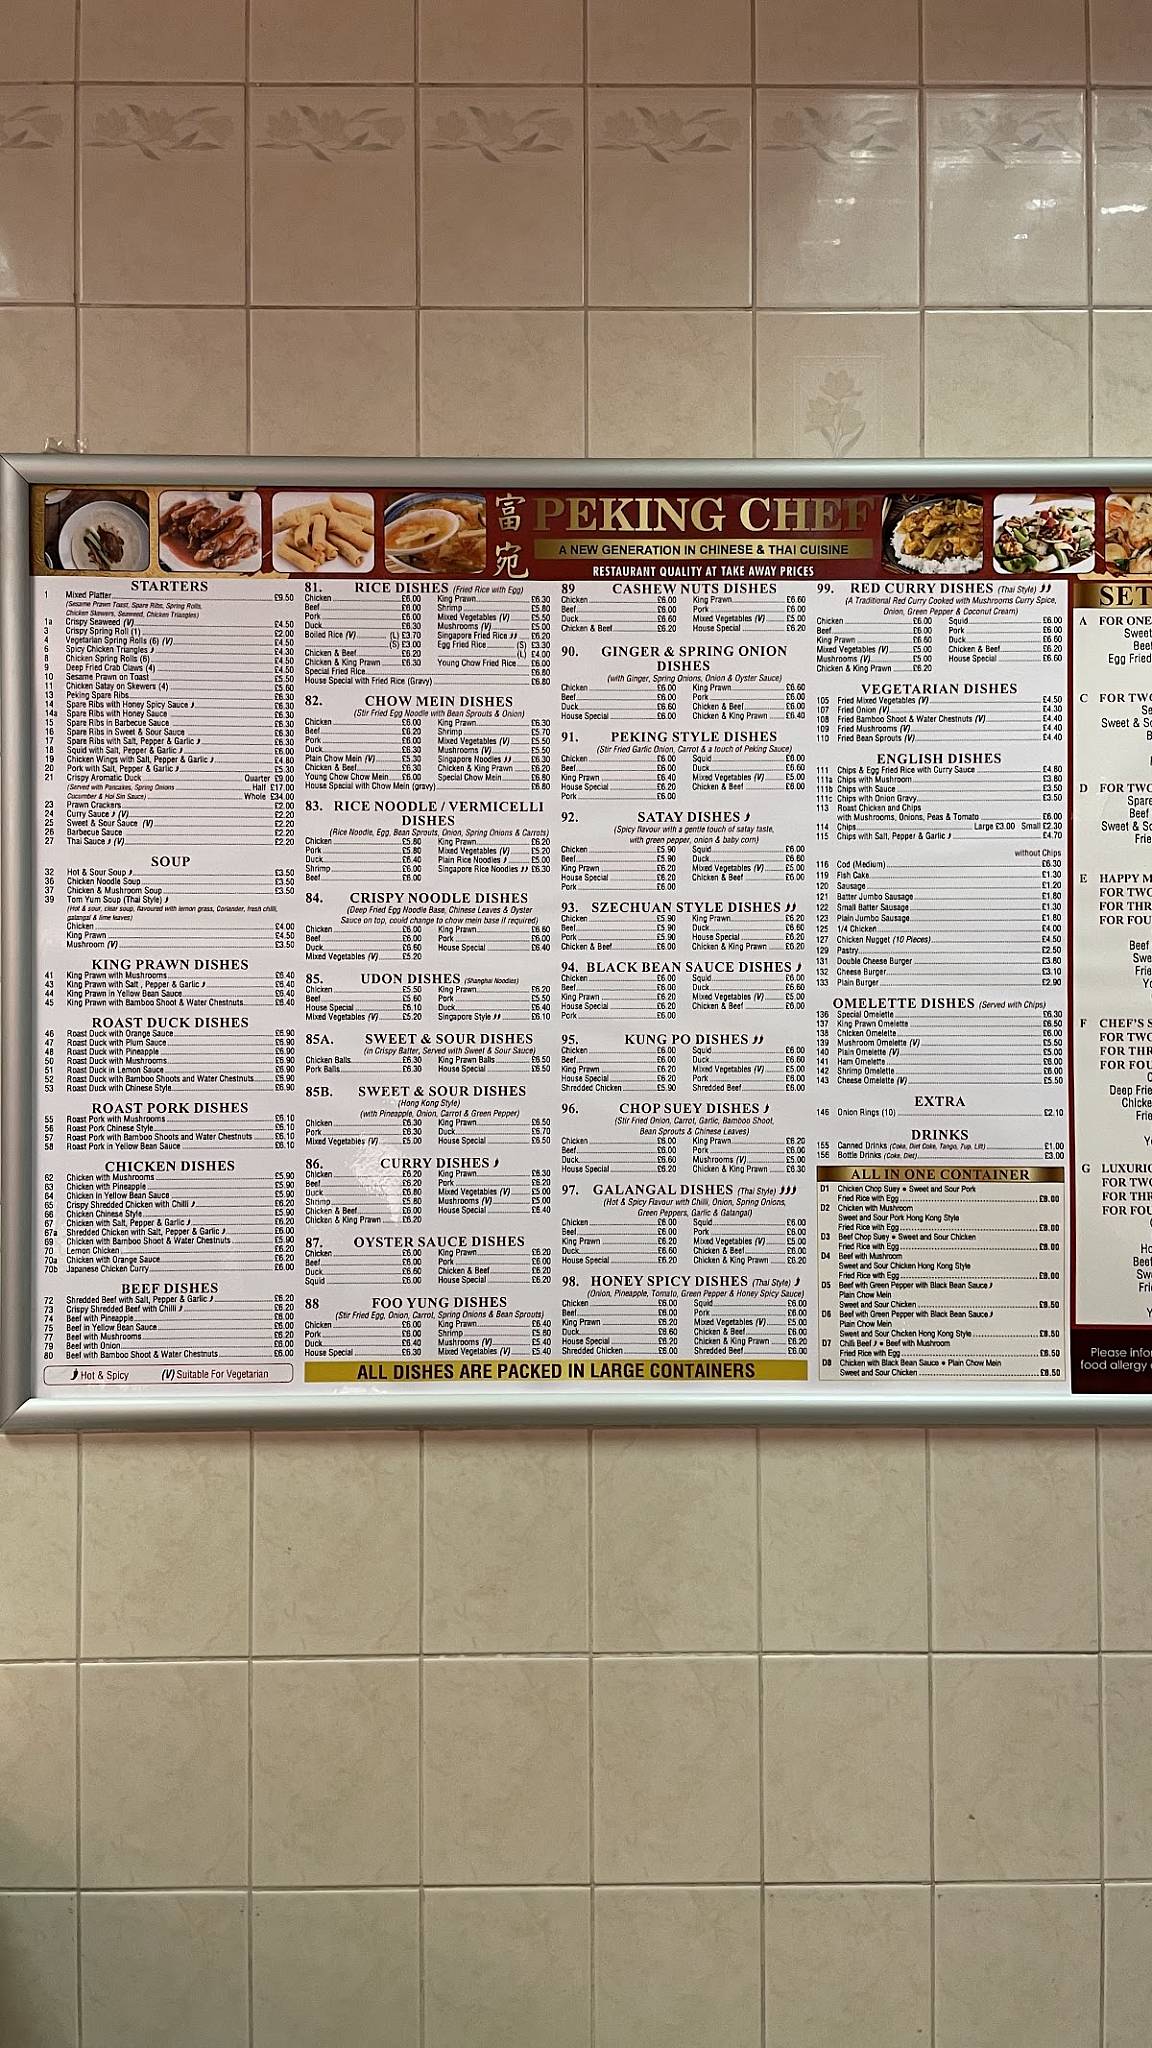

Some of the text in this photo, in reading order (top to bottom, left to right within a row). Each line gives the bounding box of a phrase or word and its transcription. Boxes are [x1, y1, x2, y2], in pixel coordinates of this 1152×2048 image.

[532, 497, 873, 532] PEKING CHEF
[559, 544, 849, 555] A NEW GENERATION IN CHINESE & THAI CUISINE
[593, 565, 814, 577] RESTAURANT QUALITY AT TAKE AWAY PRICES
[130, 580, 208, 592] STARTERS
[304, 581, 524, 595] 81. RICE DISHES (Fried Rice with Egg)
[561, 582, 777, 595] 89 CASHEW NUTS DISHES
[817, 582, 1037, 595] 99. RED CURRY DISHES (Thai Style)
[65, 590, 87, 599] Mixed
[88, 590, 112, 599] Platter
[273, 593, 295, 602] £9.50
[304, 594, 422, 603] Chicken £6.00
[1080, 617, 1087, 625] A
[1099, 616, 1123, 625] FOR
[561, 645, 788, 658] 90. GINGER & SPRING ONION
[1108, 653, 1152, 665] Egg Fried
[657, 660, 710, 672] DISHES
[44, 672, 54, 681] 10
[65, 672, 94, 681] Sesame
[95, 672, 117, 681] Prawn
[129, 672, 150, 682] Toast
[861, 682, 1018, 695] VEGETARIAN DISHES
[304, 694, 513, 708] 82. CHOW MEIN DISHES
[816, 695, 1063, 706] 105 Fried Mixed Vegetables (V) £4.50
[877, 752, 1002, 765] ENGLISH DISHES
[44, 773, 295, 783] 21 Crispy Aromatic Duck Quarter £9.00
[305, 800, 544, 812] 83. RICE NOODLE / VERMICELLI
[401, 814, 455, 827] DISHES
[561, 811, 740, 823] 92. SATAY DISHES
[974, 821, 1063, 832] Large £3.00 Small £2.30
[1014, 848, 1062, 858] without Chips
[151, 855, 191, 868] SOUP
[1080, 874, 1140, 883] E HAPPY
[92, 958, 249, 971] KING PRAWN DISHES
[305, 973, 461, 985] 85. UDON DISHES
[832, 997, 975, 1009] OMELETTE DISHES
[92, 1017, 249, 1029] ROAST DUCK DISHES
[397, 1099, 461, 1109] (Hong Kong Style)
[914, 1095, 966, 1107] EXTRA
[911, 1129, 969, 1141] DRINKS
[104, 1160, 235, 1173] CHICKEN DISHES
[305, 1157, 490, 1170] 86. CURRY DISHES
[850, 1168, 881, 1180] ALL
[884, 1168, 900, 1181] IN
[940, 1168, 1030, 1181] CONTAINER
[561, 1184, 733, 1196] 97. GALANGAL DISHES
[305, 1235, 525, 1249] 87. OYSTER SAUCE DISHES
[44, 1246, 54, 1256] 70
[66, 1246, 91, 1255] Lemon
[92, 1246, 120, 1255] Chicken
[121, 1282, 219, 1295] BEEF DISHES
[1090, 1347, 1127, 1358] Please
[357, 1363, 756, 1380] ALL DISHES ARE PACKED IN LARGE CONTAINERS
[1080, 1360, 1148, 1372] food allergy
[80, 1370, 130, 1382] Hot & Spicy
[161, 1368, 269, 1381] (V) Suitable For Vegetarian
